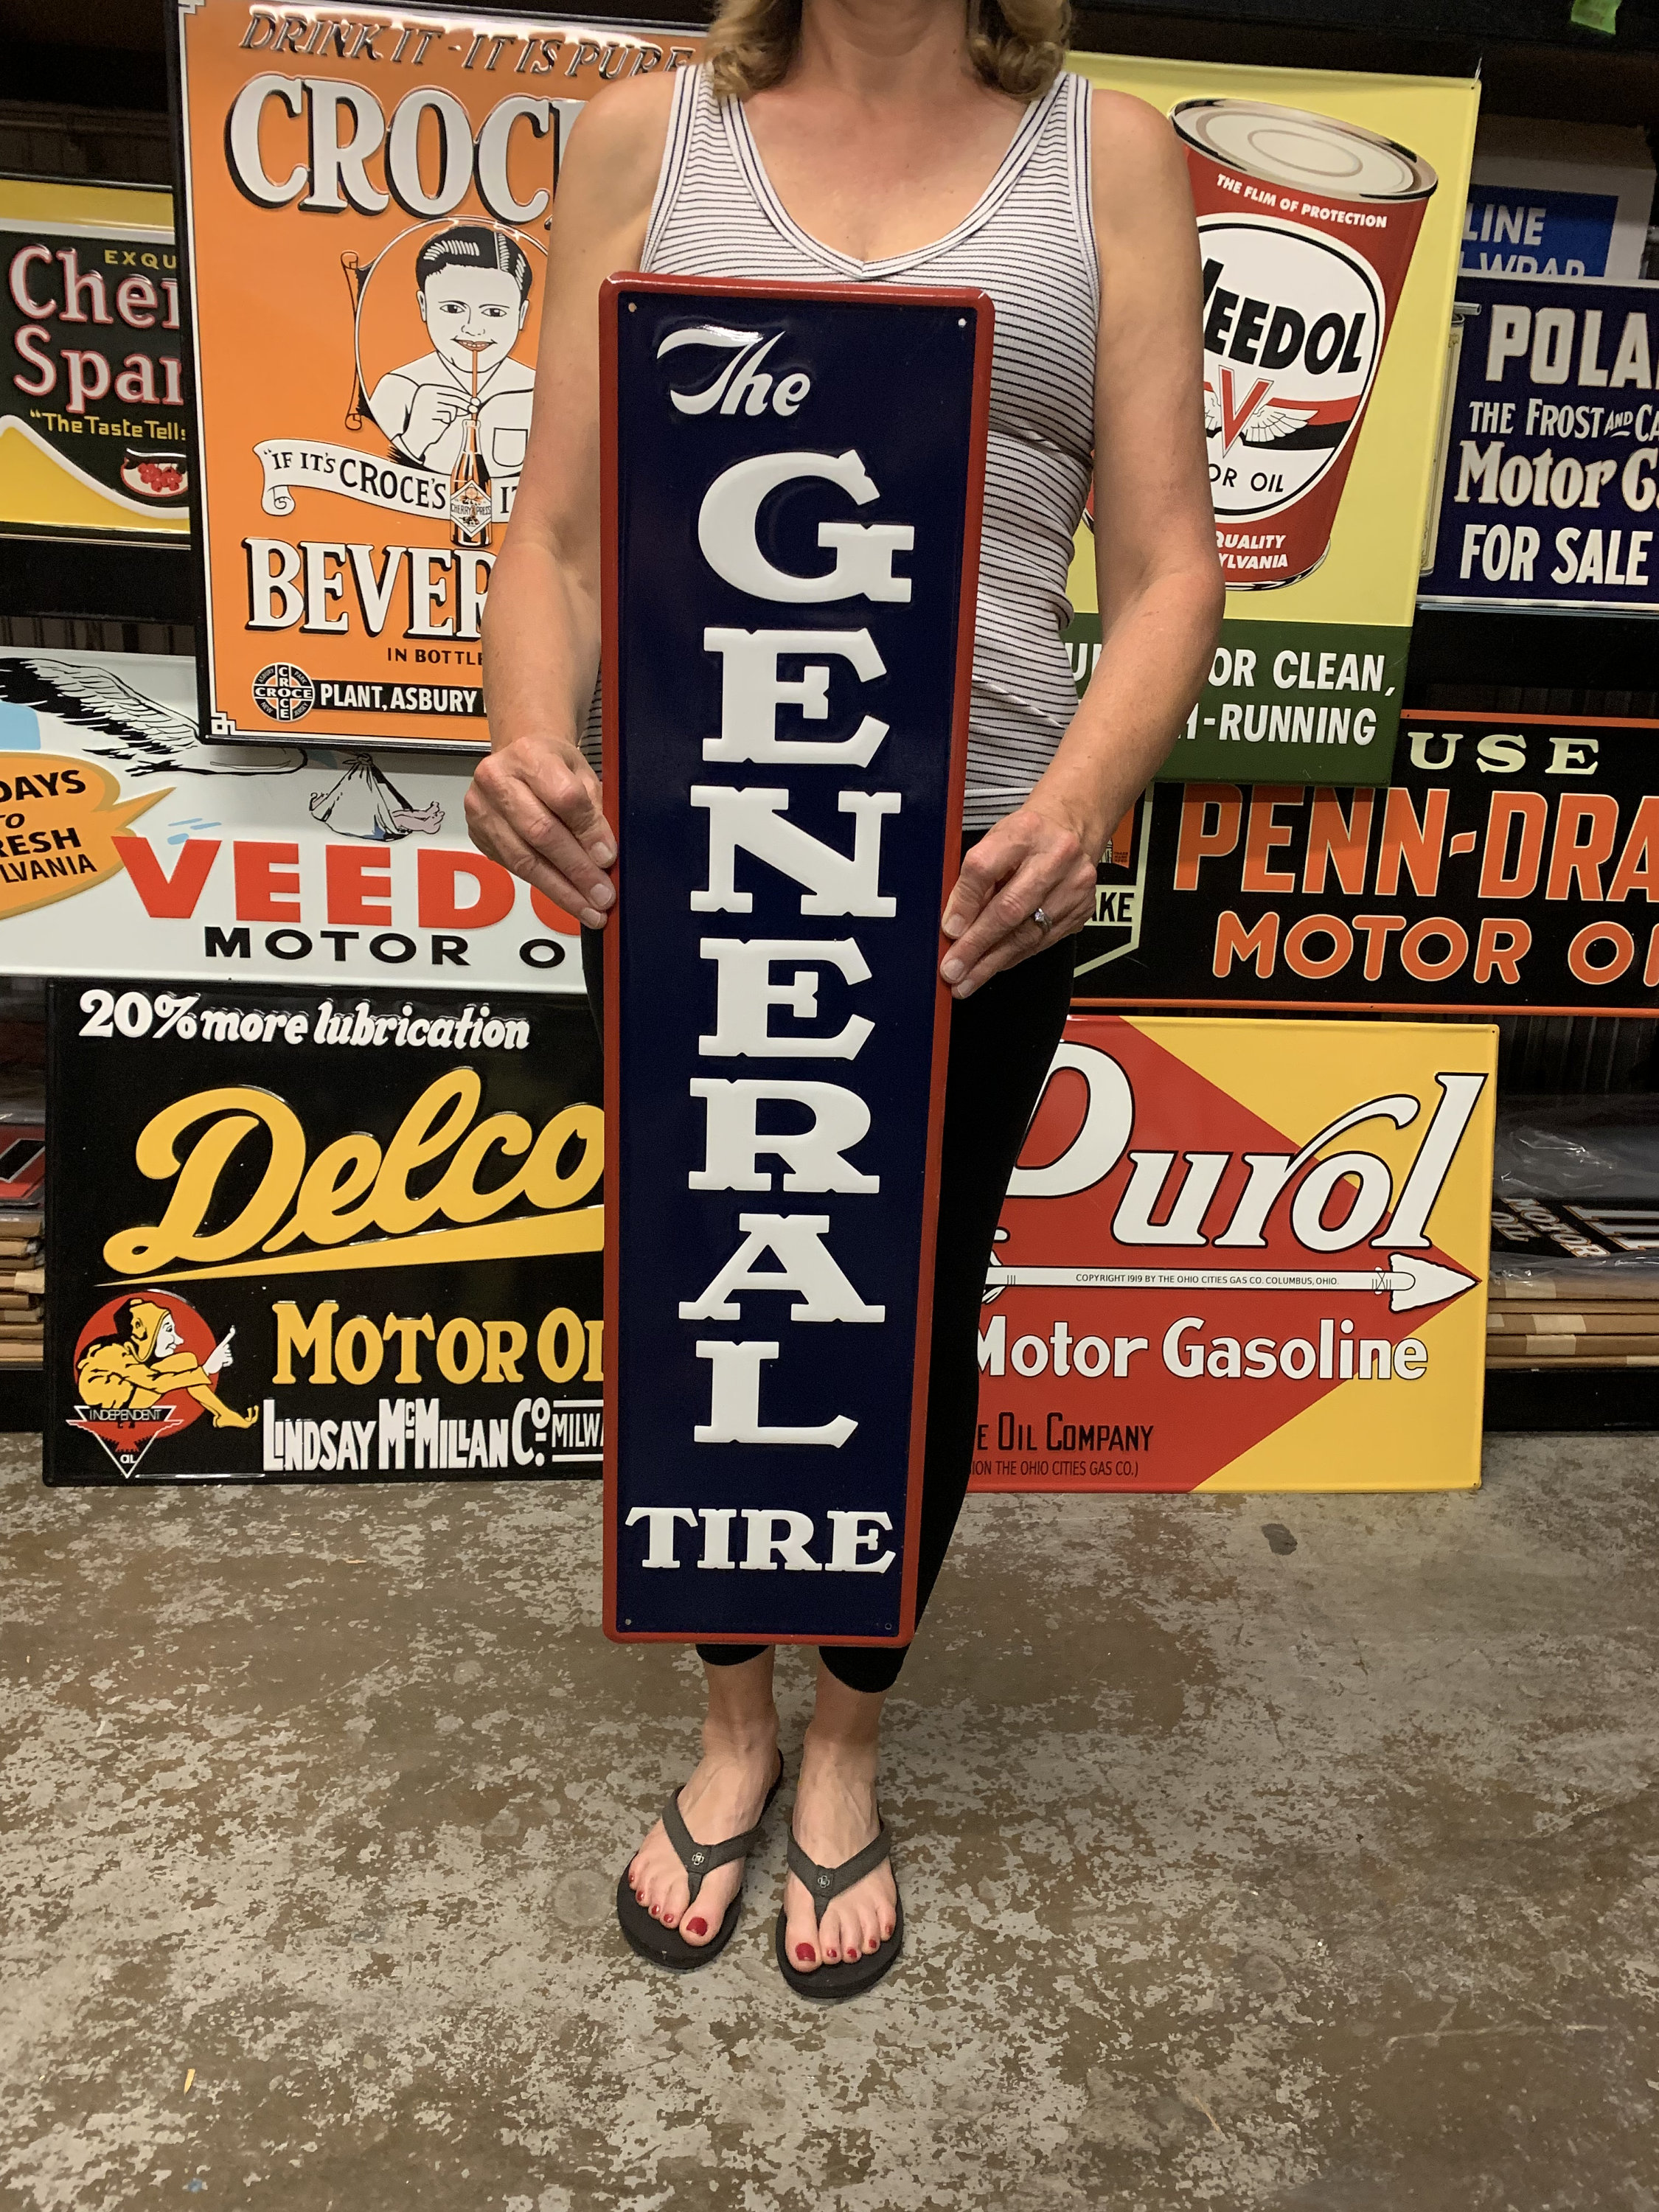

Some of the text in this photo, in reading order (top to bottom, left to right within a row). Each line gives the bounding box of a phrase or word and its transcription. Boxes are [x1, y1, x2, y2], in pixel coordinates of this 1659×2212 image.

[239, 10, 383, 60] DRINK
[391, 27, 441, 63] IT
[463, 32, 515, 69] IT
[516, 37, 563, 74] IS
[224, 72, 590, 230] CROC
[1217, 173, 1388, 228] THE FLIM OF PROTECTION
[657, 327, 812, 417] The
[1486, 304, 1659, 389] POLA
[84, 415, 144, 438] Taste
[1470, 401, 1516, 434] THE
[339, 459, 446, 510] CROCE'S
[1251, 472, 1284, 493] OIL
[1454, 440, 1618, 509] Motor
[1460, 524, 1654, 585] FOR SALE
[387, 647, 408, 661] IN
[1273, 650, 1395, 697] CLEAN,
[254, 686, 313, 698] CROCE
[320, 683, 388, 712] PLANT,
[390, 686, 478, 713] ASBURY
[1408, 731, 1599, 774] USE
[0, 813, 25, 829] O
[1091, 891, 1135, 923] KE
[204, 926, 472, 967] MOTOR
[678, 449, 915, 1449] GENERAL
[1212, 911, 1532, 985] MOTOR
[78, 988, 531, 1051] 20% more lubrication
[102, 1066, 604, 1275] Delco
[1075, 1273, 1127, 1284] COPYRIGHT
[1144, 1274, 1158, 1284] BY
[1158, 1275, 1175, 1284] THE
[1177, 1275, 1200, 1285] OHIO
[1201, 1276, 1228, 1286] CITIES
[1229, 1276, 1248, 1286] GAS
[1249, 1276, 1264, 1286] CO.
[1265, 1276, 1315, 1287] COLUMBUS,
[1315, 1278, 1340, 1287] OHIO.
[271, 1300, 528, 1385] MOTOR
[1161, 1315, 1429, 1381] Gasoline
[89, 1409, 162, 1421] INDEPENDENT
[262, 1398, 377, 1472] LINDSAY
[551, 1412, 604, 1448] MILW
[998, 1411, 1038, 1451] OIL
[995, 1461, 1018, 1475] THE
[1020, 1461, 1050, 1475] OHIO
[1051, 1461, 1087, 1476] CITIES
[1089, 1461, 1112, 1476] GAS
[1114, 1461, 1140, 1478] CO.)
[625, 1506, 897, 1573] TIRE
